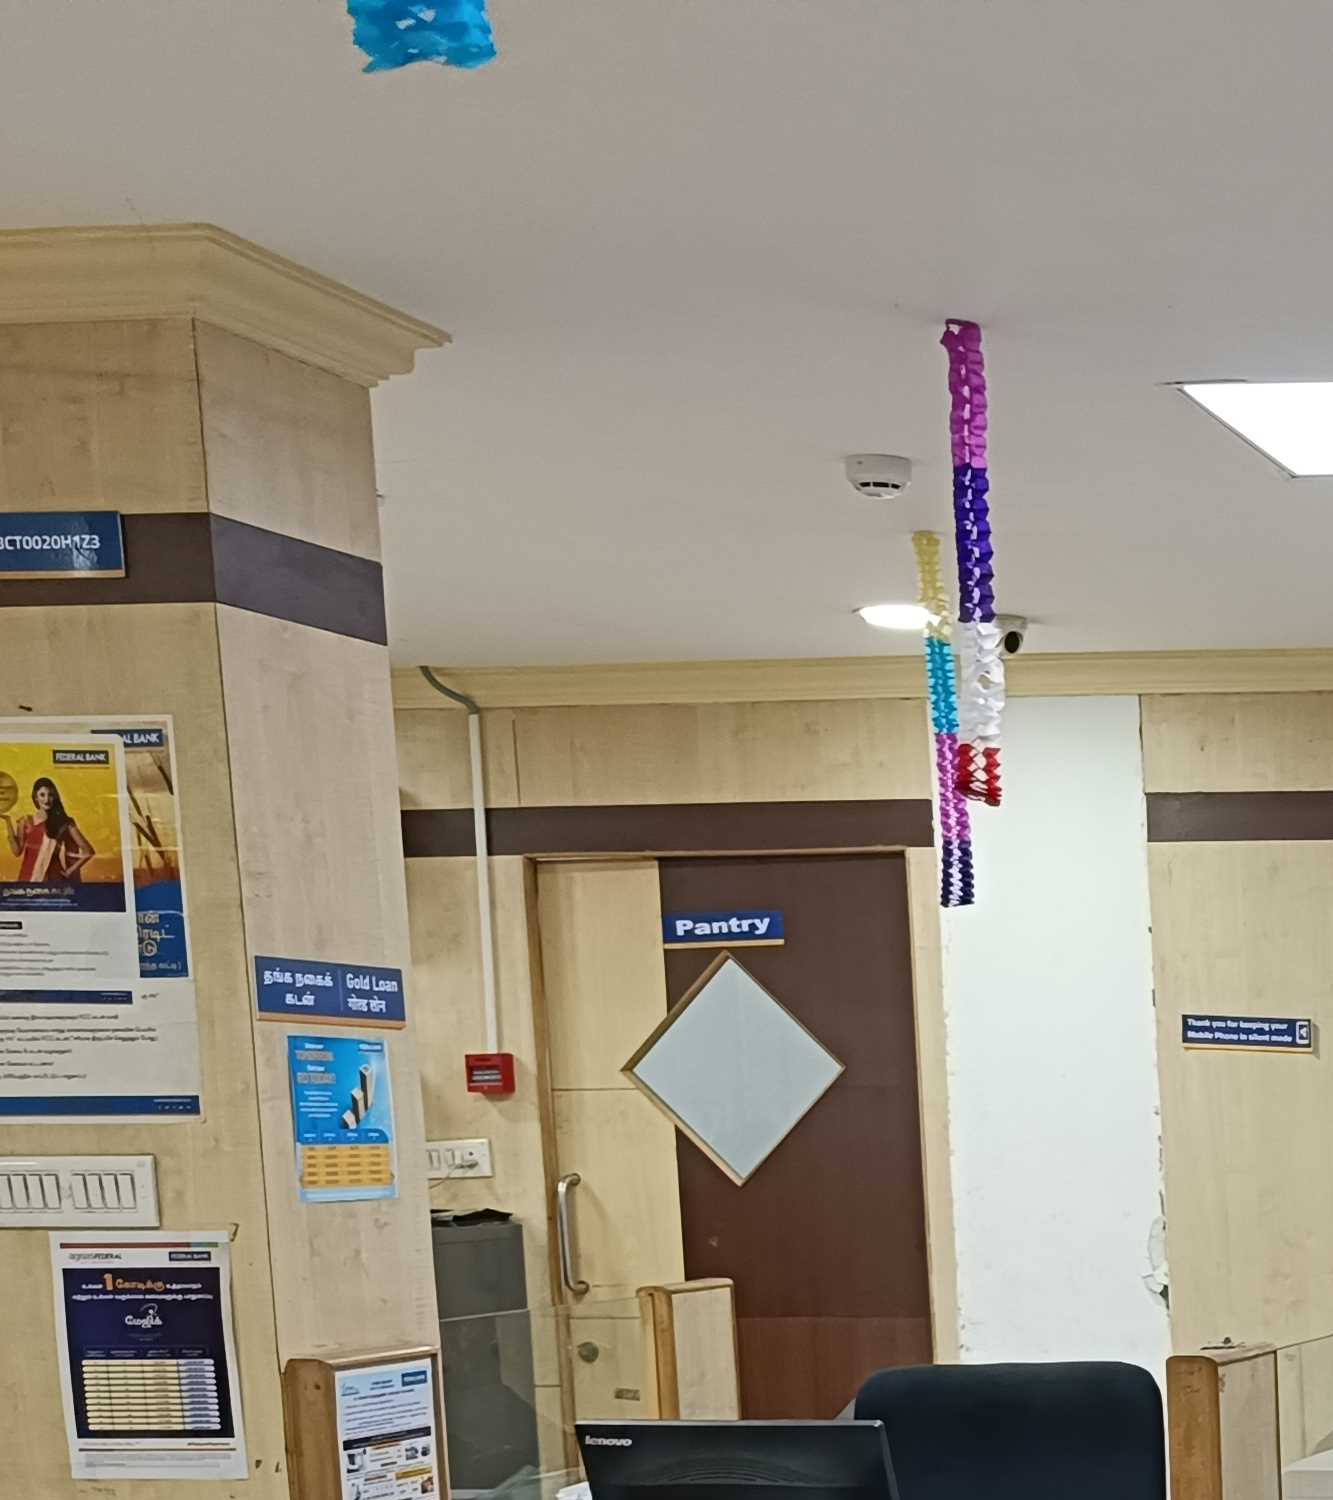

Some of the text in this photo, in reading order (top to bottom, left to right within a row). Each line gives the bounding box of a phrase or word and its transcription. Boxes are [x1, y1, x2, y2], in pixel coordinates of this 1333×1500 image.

[134, 733, 160, 743] BANK
[675, 917, 770, 936] Pantry
[263, 967, 333, 988] தங்க நகைக்
[346, 973, 398, 993] Gold Loan
[285, 991, 315, 1006] கடன்
[1187, 1018, 1210, 1026] Thank
[1212, 1021, 1226, 1029] you
[1240, 1020, 1269, 1031] keeping
[1271, 1023, 1288, 1031] your
[1187, 1031, 1213, 1039] Mobile
[1214, 1032, 1239, 1040] Phone
[1248, 1033, 1269, 1041] silent
[103, 1273, 114, 1291] 1
